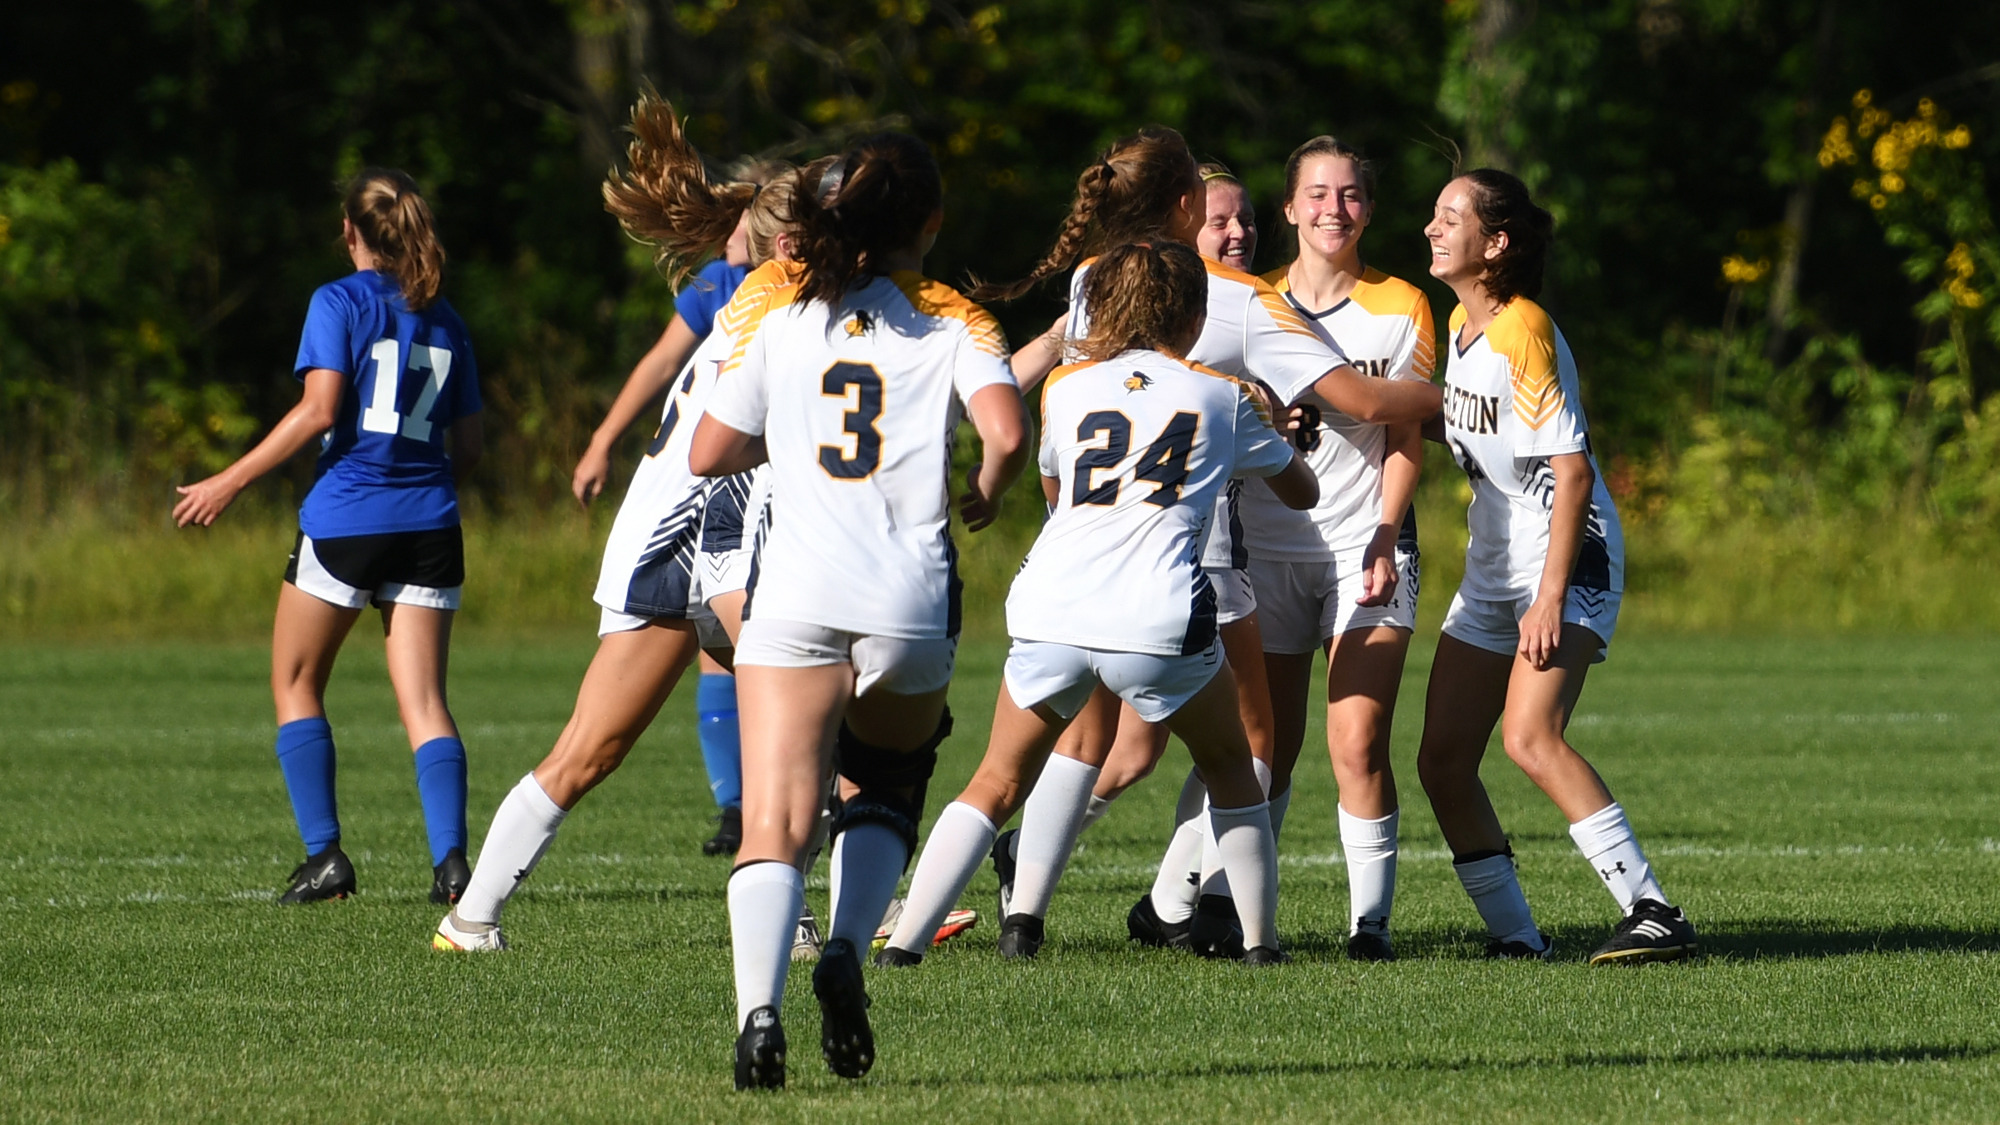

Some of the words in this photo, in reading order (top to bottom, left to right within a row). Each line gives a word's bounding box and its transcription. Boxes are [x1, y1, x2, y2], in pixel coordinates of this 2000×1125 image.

[362, 337, 452, 443] 17
[817, 358, 886, 483] 3
[1071, 408, 1202, 509] 24
